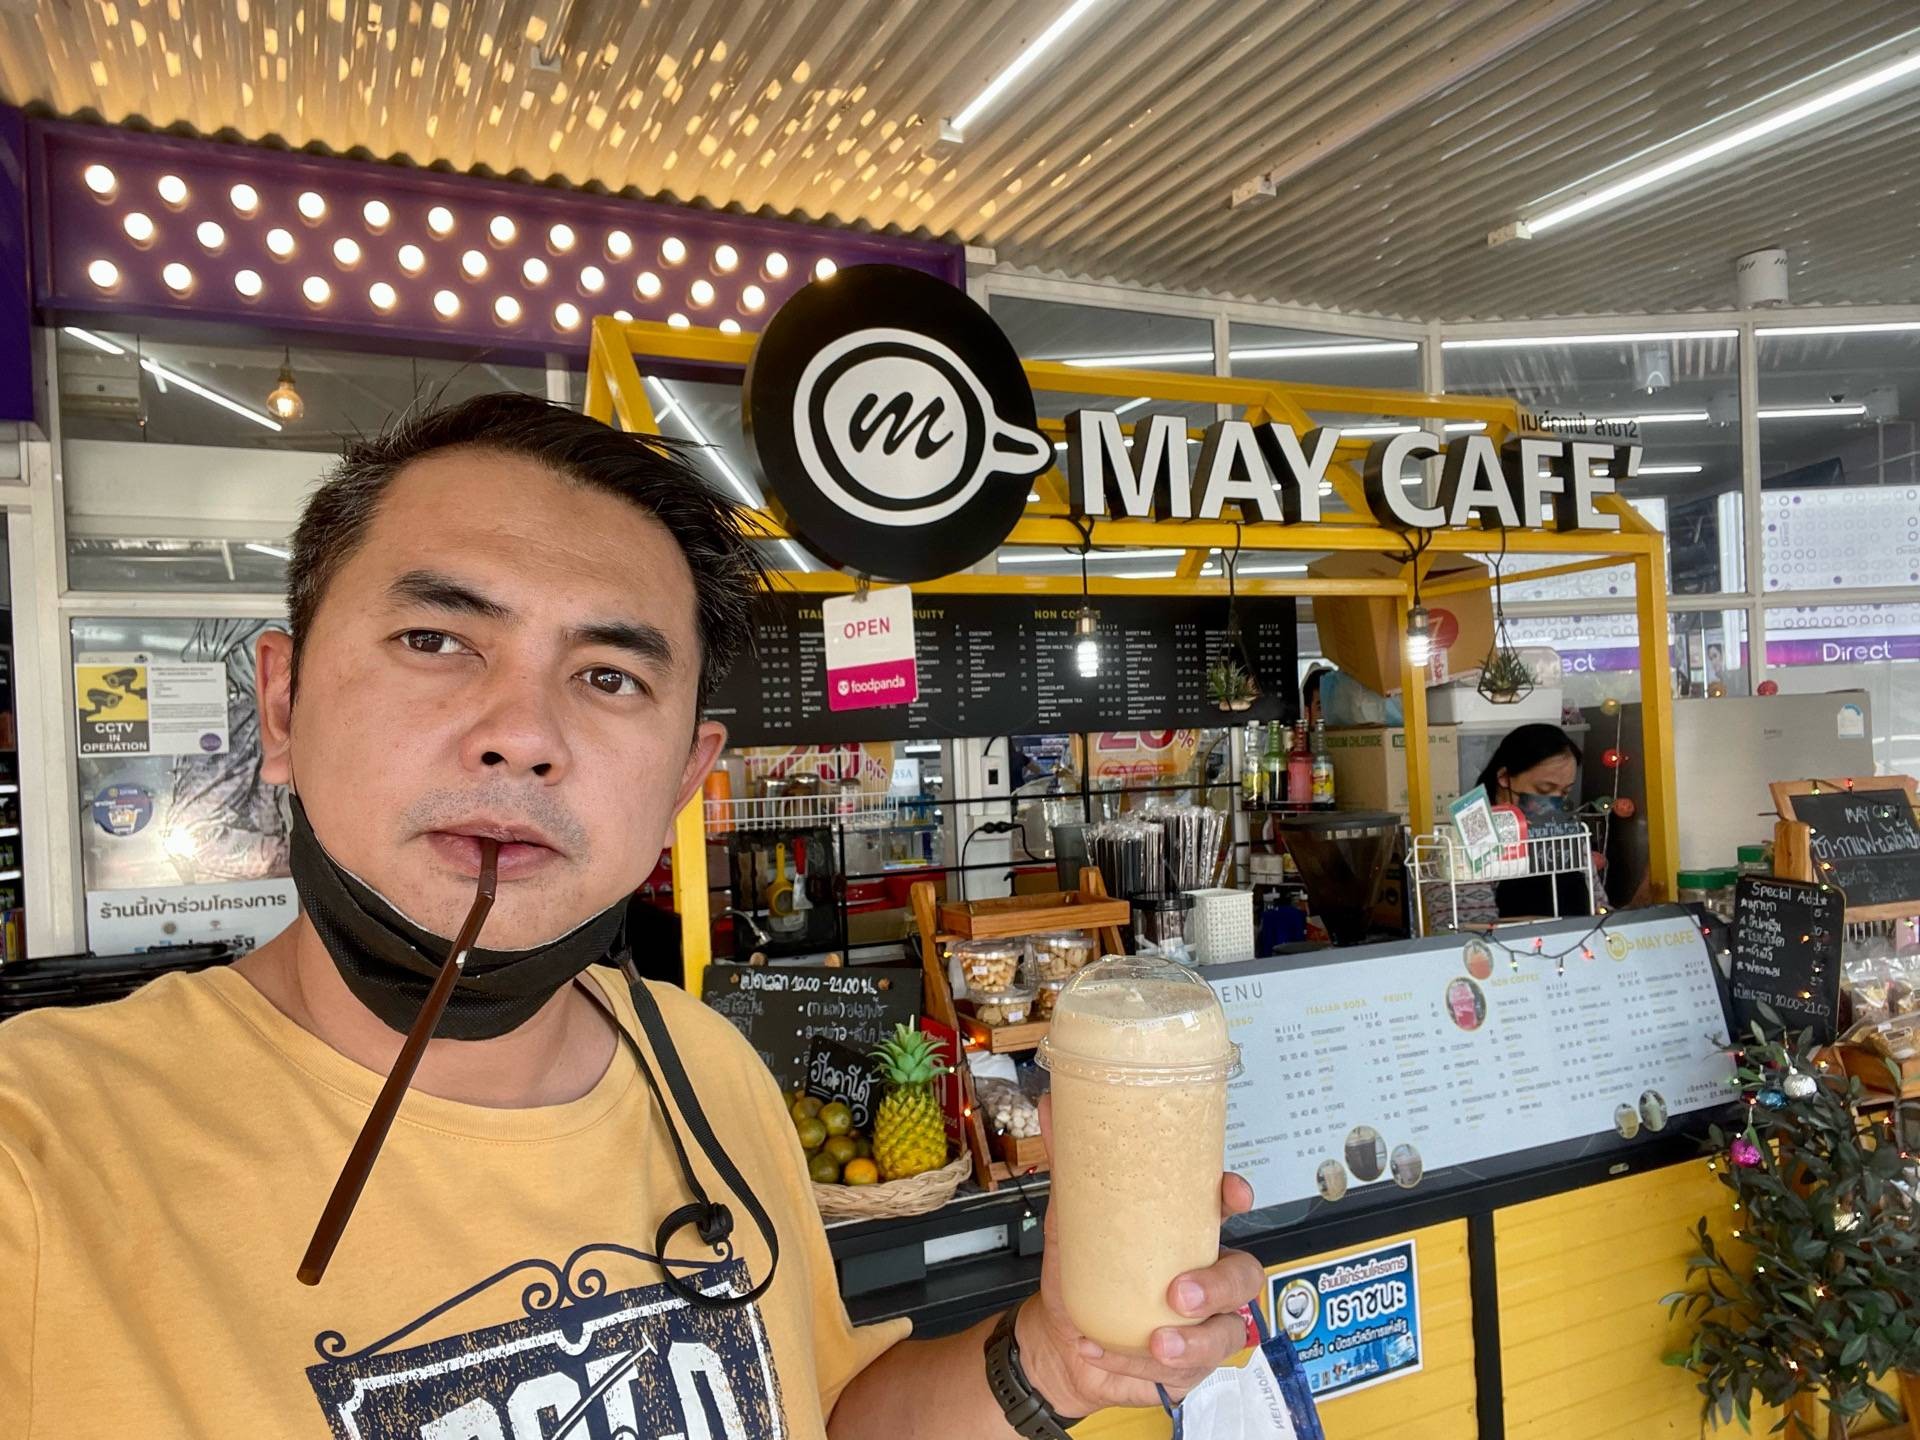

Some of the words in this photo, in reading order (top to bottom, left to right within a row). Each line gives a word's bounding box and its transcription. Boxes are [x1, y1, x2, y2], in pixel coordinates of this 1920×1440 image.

[1073, 408, 1341, 522] MAY
[798, 609, 824, 619] ITAL
[912, 609, 945, 620] RUITY
[1034, 610, 1057, 620] NON
[843, 617, 890, 639] OPEN
[1823, 640, 1892, 662] Direct
[1561, 653, 1596, 673] ect
[851, 675, 905, 694] foodpanda
[95, 722, 134, 734] CCTV
[83, 742, 147, 752] OPERATION
[109, 734, 120, 742] IN
[1751, 882, 1792, 901] Special
[100, 892, 287, 919] ร้านนี้เข้าร่วมโครงการ
[1637, 936, 1661, 949] MAY
[1664, 931, 1695, 946] CAFE
[1222, 982, 1263, 1003] ENU
[1328, 1284, 1405, 1328] เราชนะ
